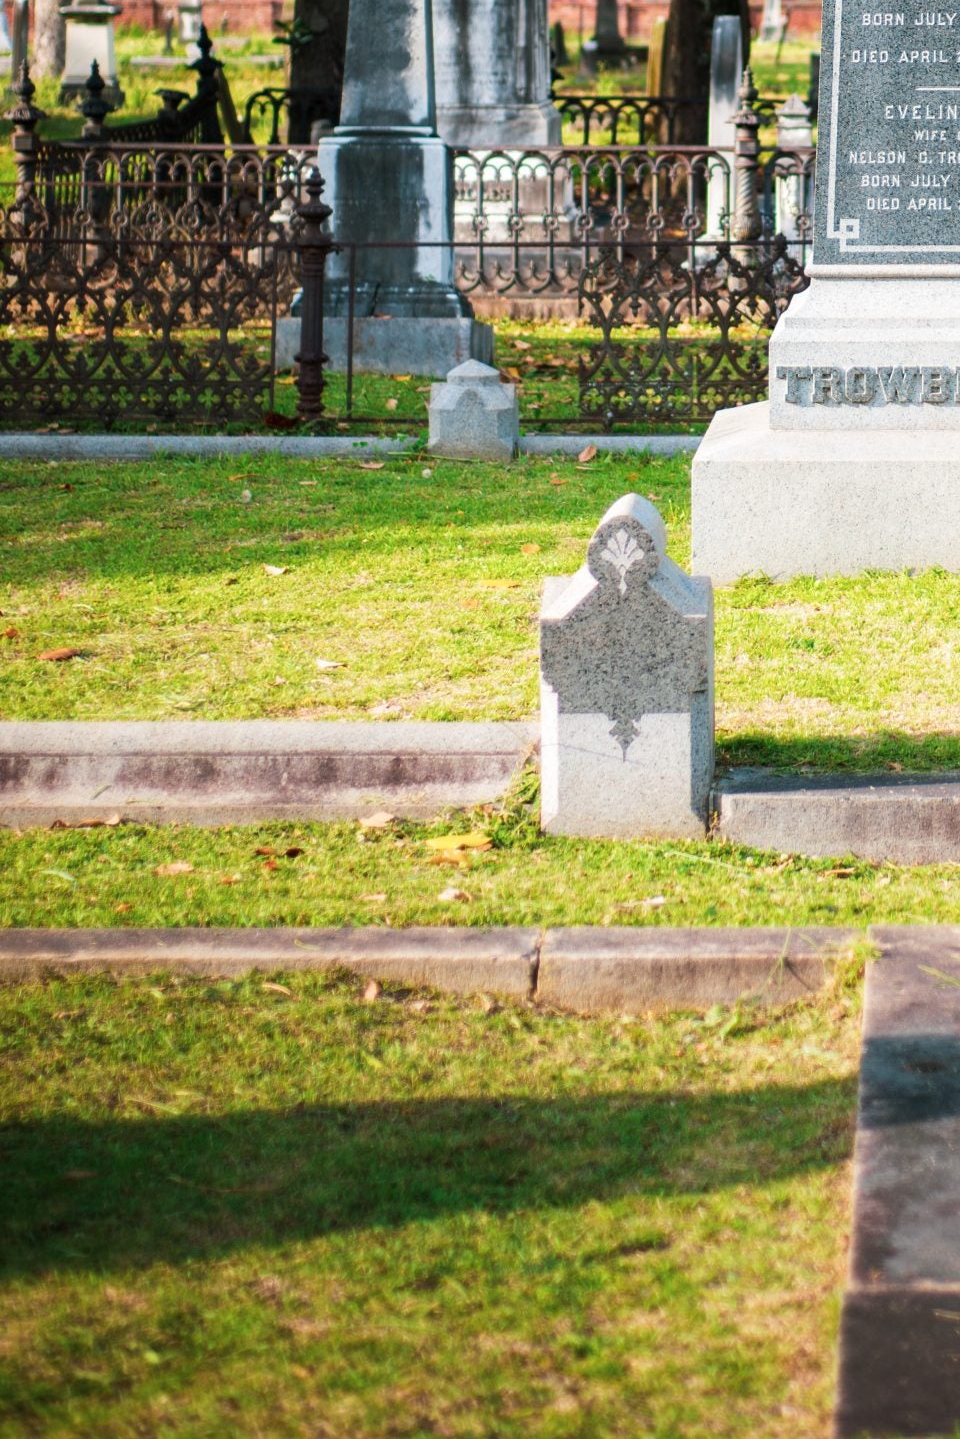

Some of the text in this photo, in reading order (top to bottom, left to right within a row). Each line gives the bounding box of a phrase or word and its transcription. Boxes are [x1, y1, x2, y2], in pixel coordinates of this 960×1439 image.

[862, 13, 904, 26] BORN
[914, 13, 957, 26] JULY
[852, 50, 888, 63] DIED
[899, 50, 948, 63] APRIL
[914, 130, 947, 140] WIFE
[850, 151, 906, 163] NELSON
[860, 174, 900, 187] BORN
[911, 174, 950, 187] JULY
[867, 198, 899, 210] DIED
[907, 198, 951, 210] APRIL
